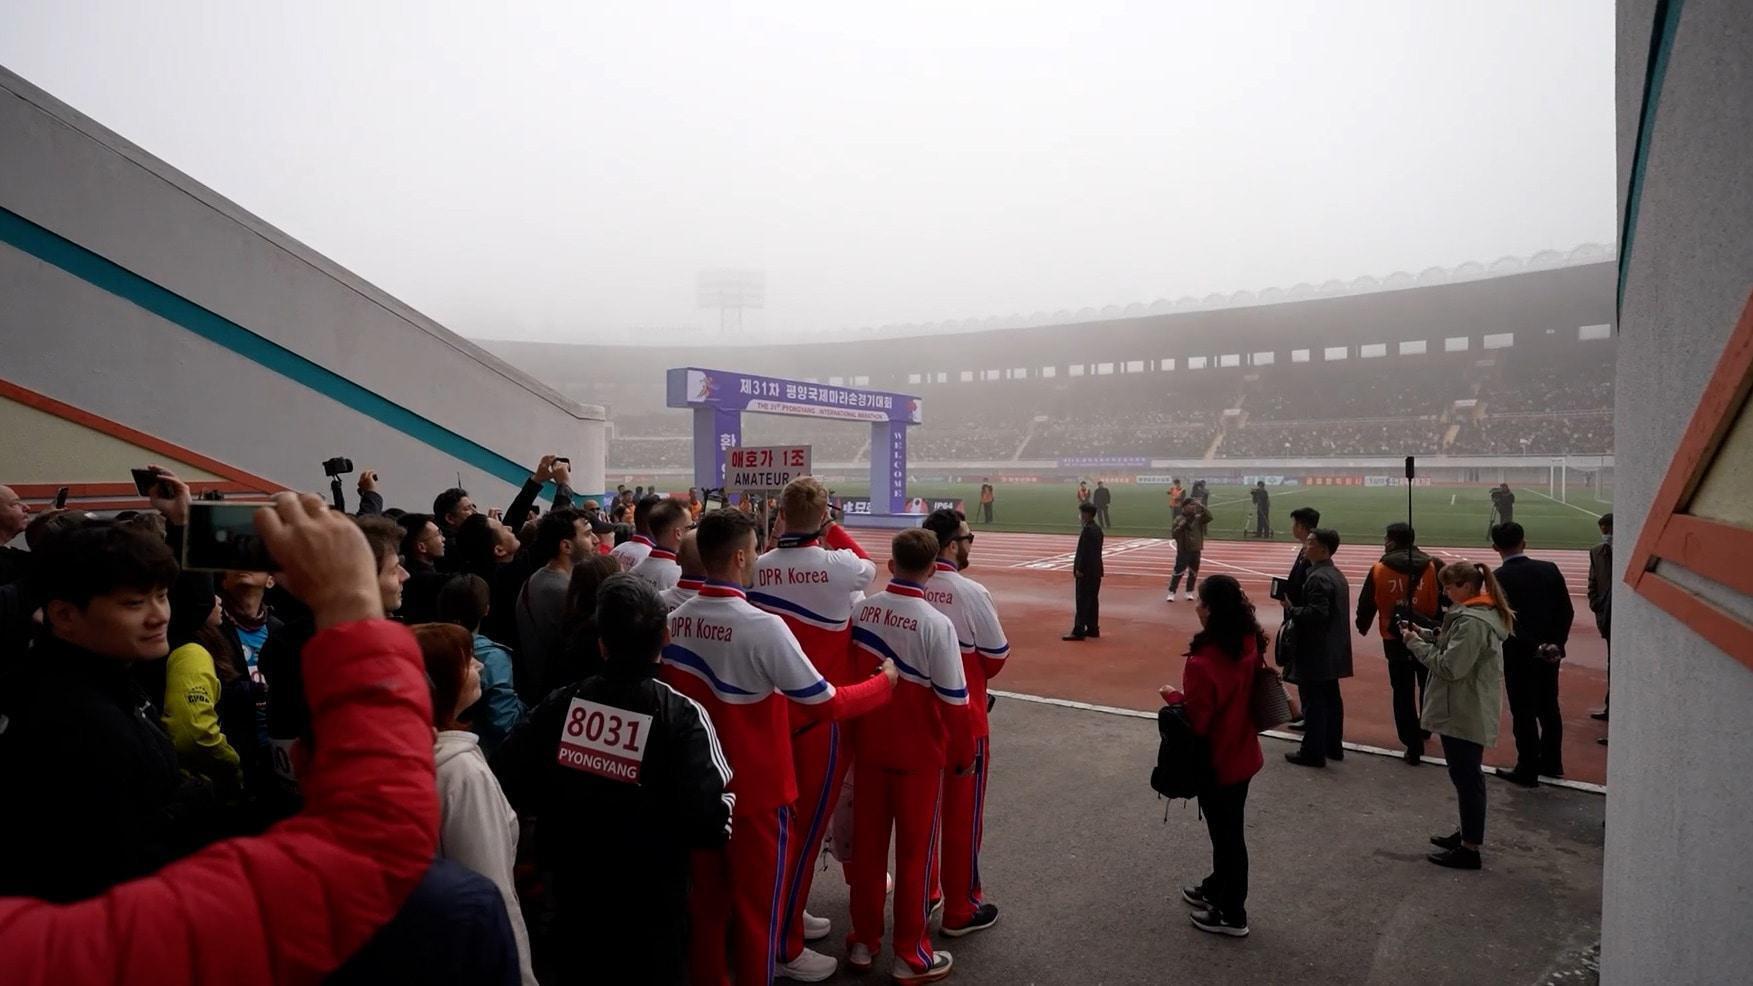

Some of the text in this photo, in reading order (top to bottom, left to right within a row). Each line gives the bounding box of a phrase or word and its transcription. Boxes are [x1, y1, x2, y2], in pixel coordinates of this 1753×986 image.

[740, 378, 780, 397] 제31차
[731, 448, 805, 468] 애호가 1조
[893, 432, 902, 497] WELCOME
[734, 472, 789, 486] AMATEUR
[759, 567, 829, 586] DPR Korea
[671, 616, 733, 642] DPR Korea
[860, 606, 918, 632] DPR Korea
[567, 706, 640, 752] 8031
[559, 747, 637, 779] PYONGYANG
